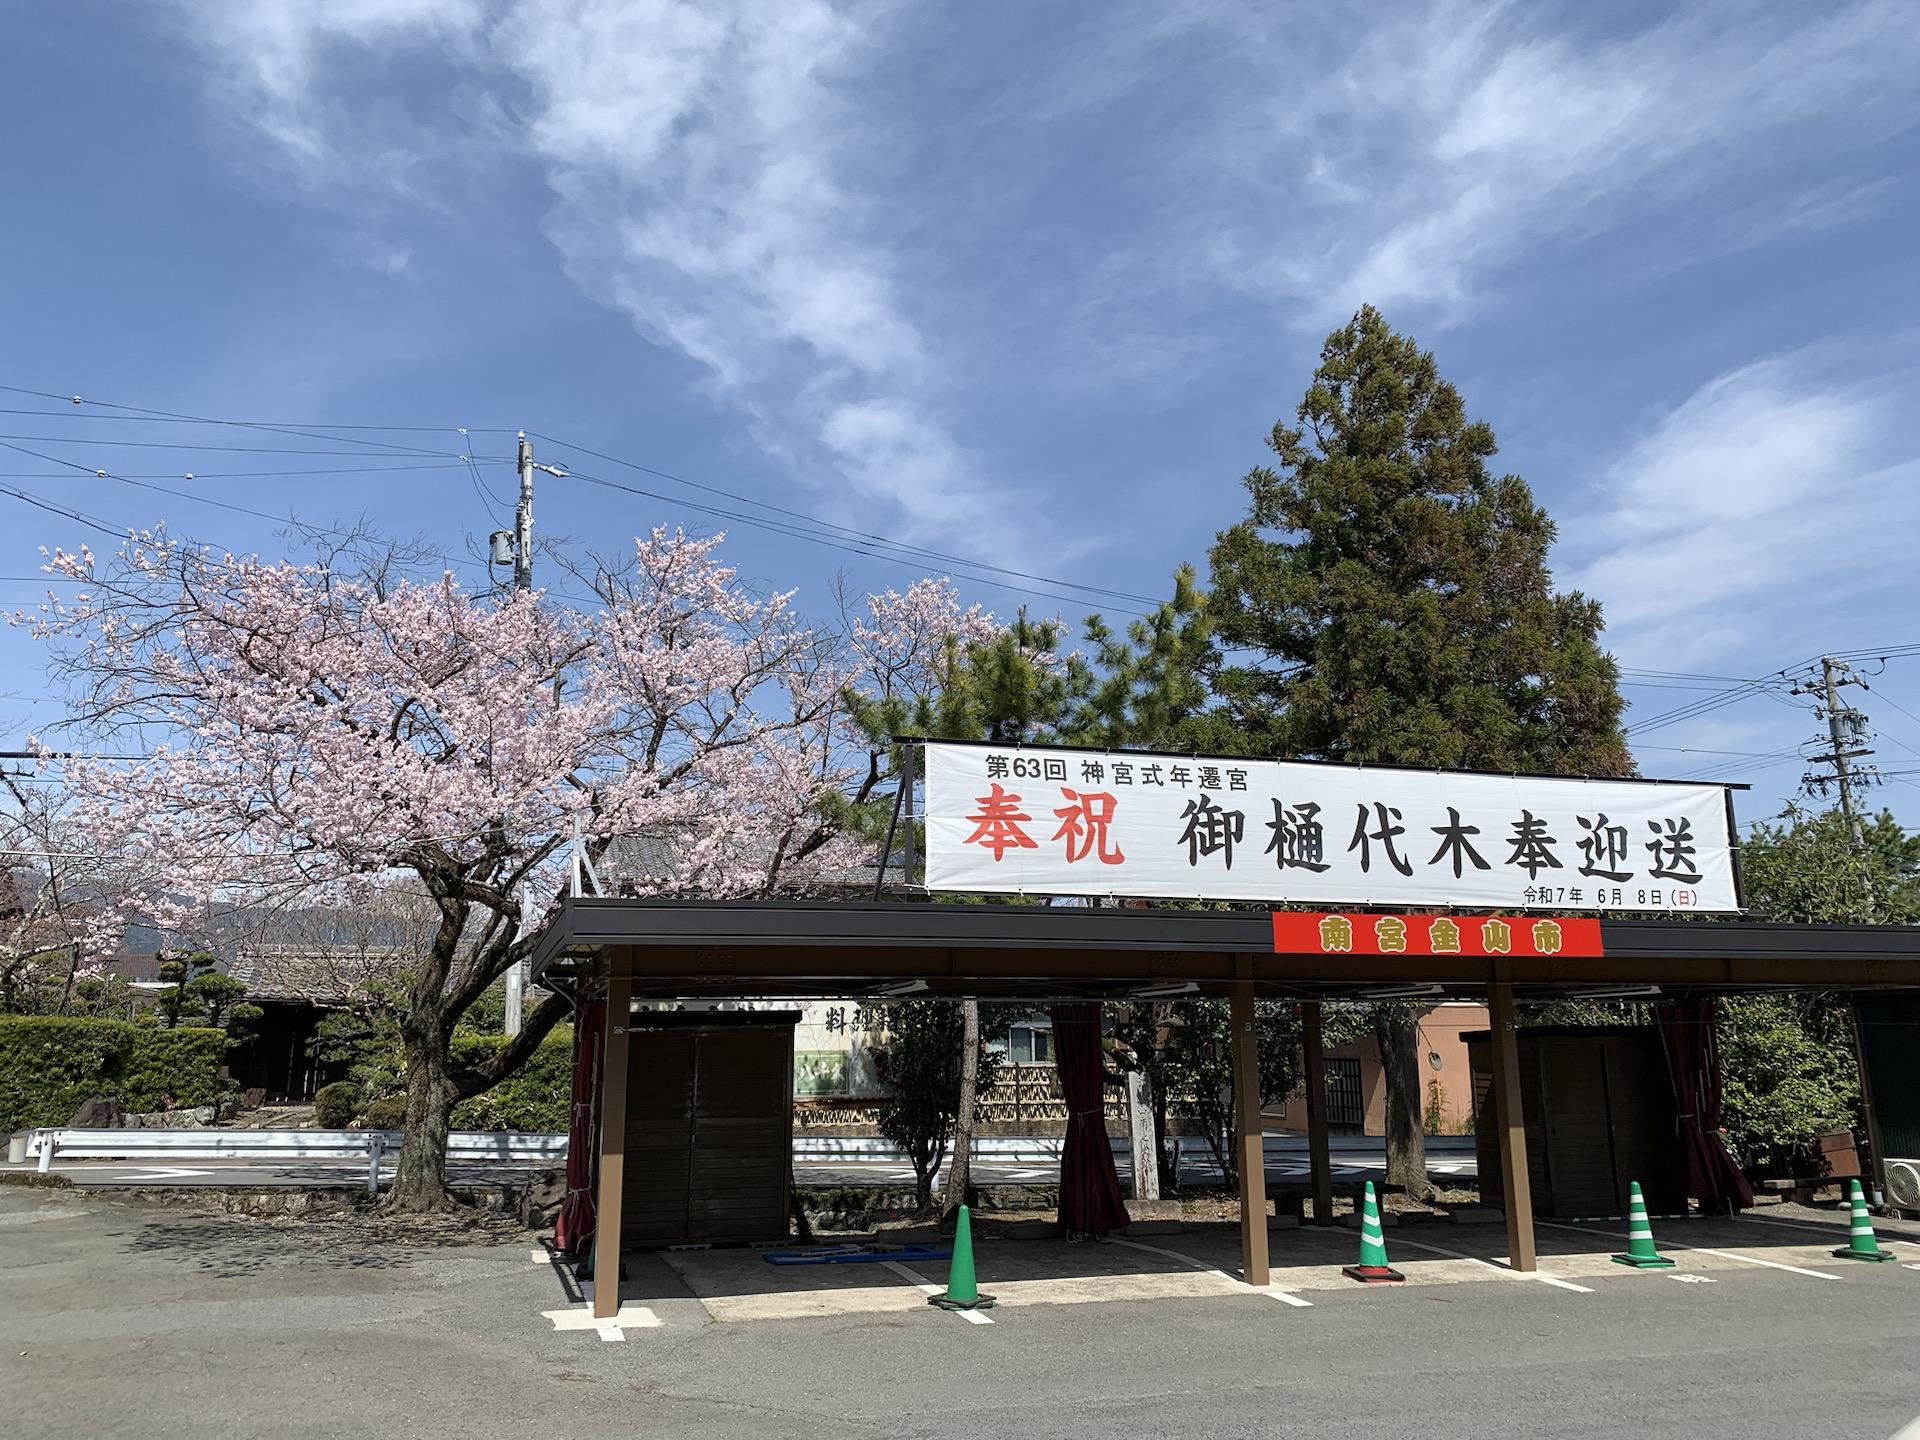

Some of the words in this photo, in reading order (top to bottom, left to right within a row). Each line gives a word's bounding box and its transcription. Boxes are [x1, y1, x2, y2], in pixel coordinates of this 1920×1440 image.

[984, 754, 1068, 782] 第63回
[1080, 759, 1248, 792] 神宮式年遷宮
[962, 782, 1126, 866] 奉祝
[1176, 793, 1704, 885] 御樋代木奉迎送
[1522, 885, 1584, 905] 令和7年
[1597, 887, 1623, 906] 6月
[1318, 914, 1563, 955] 南宮金山市
